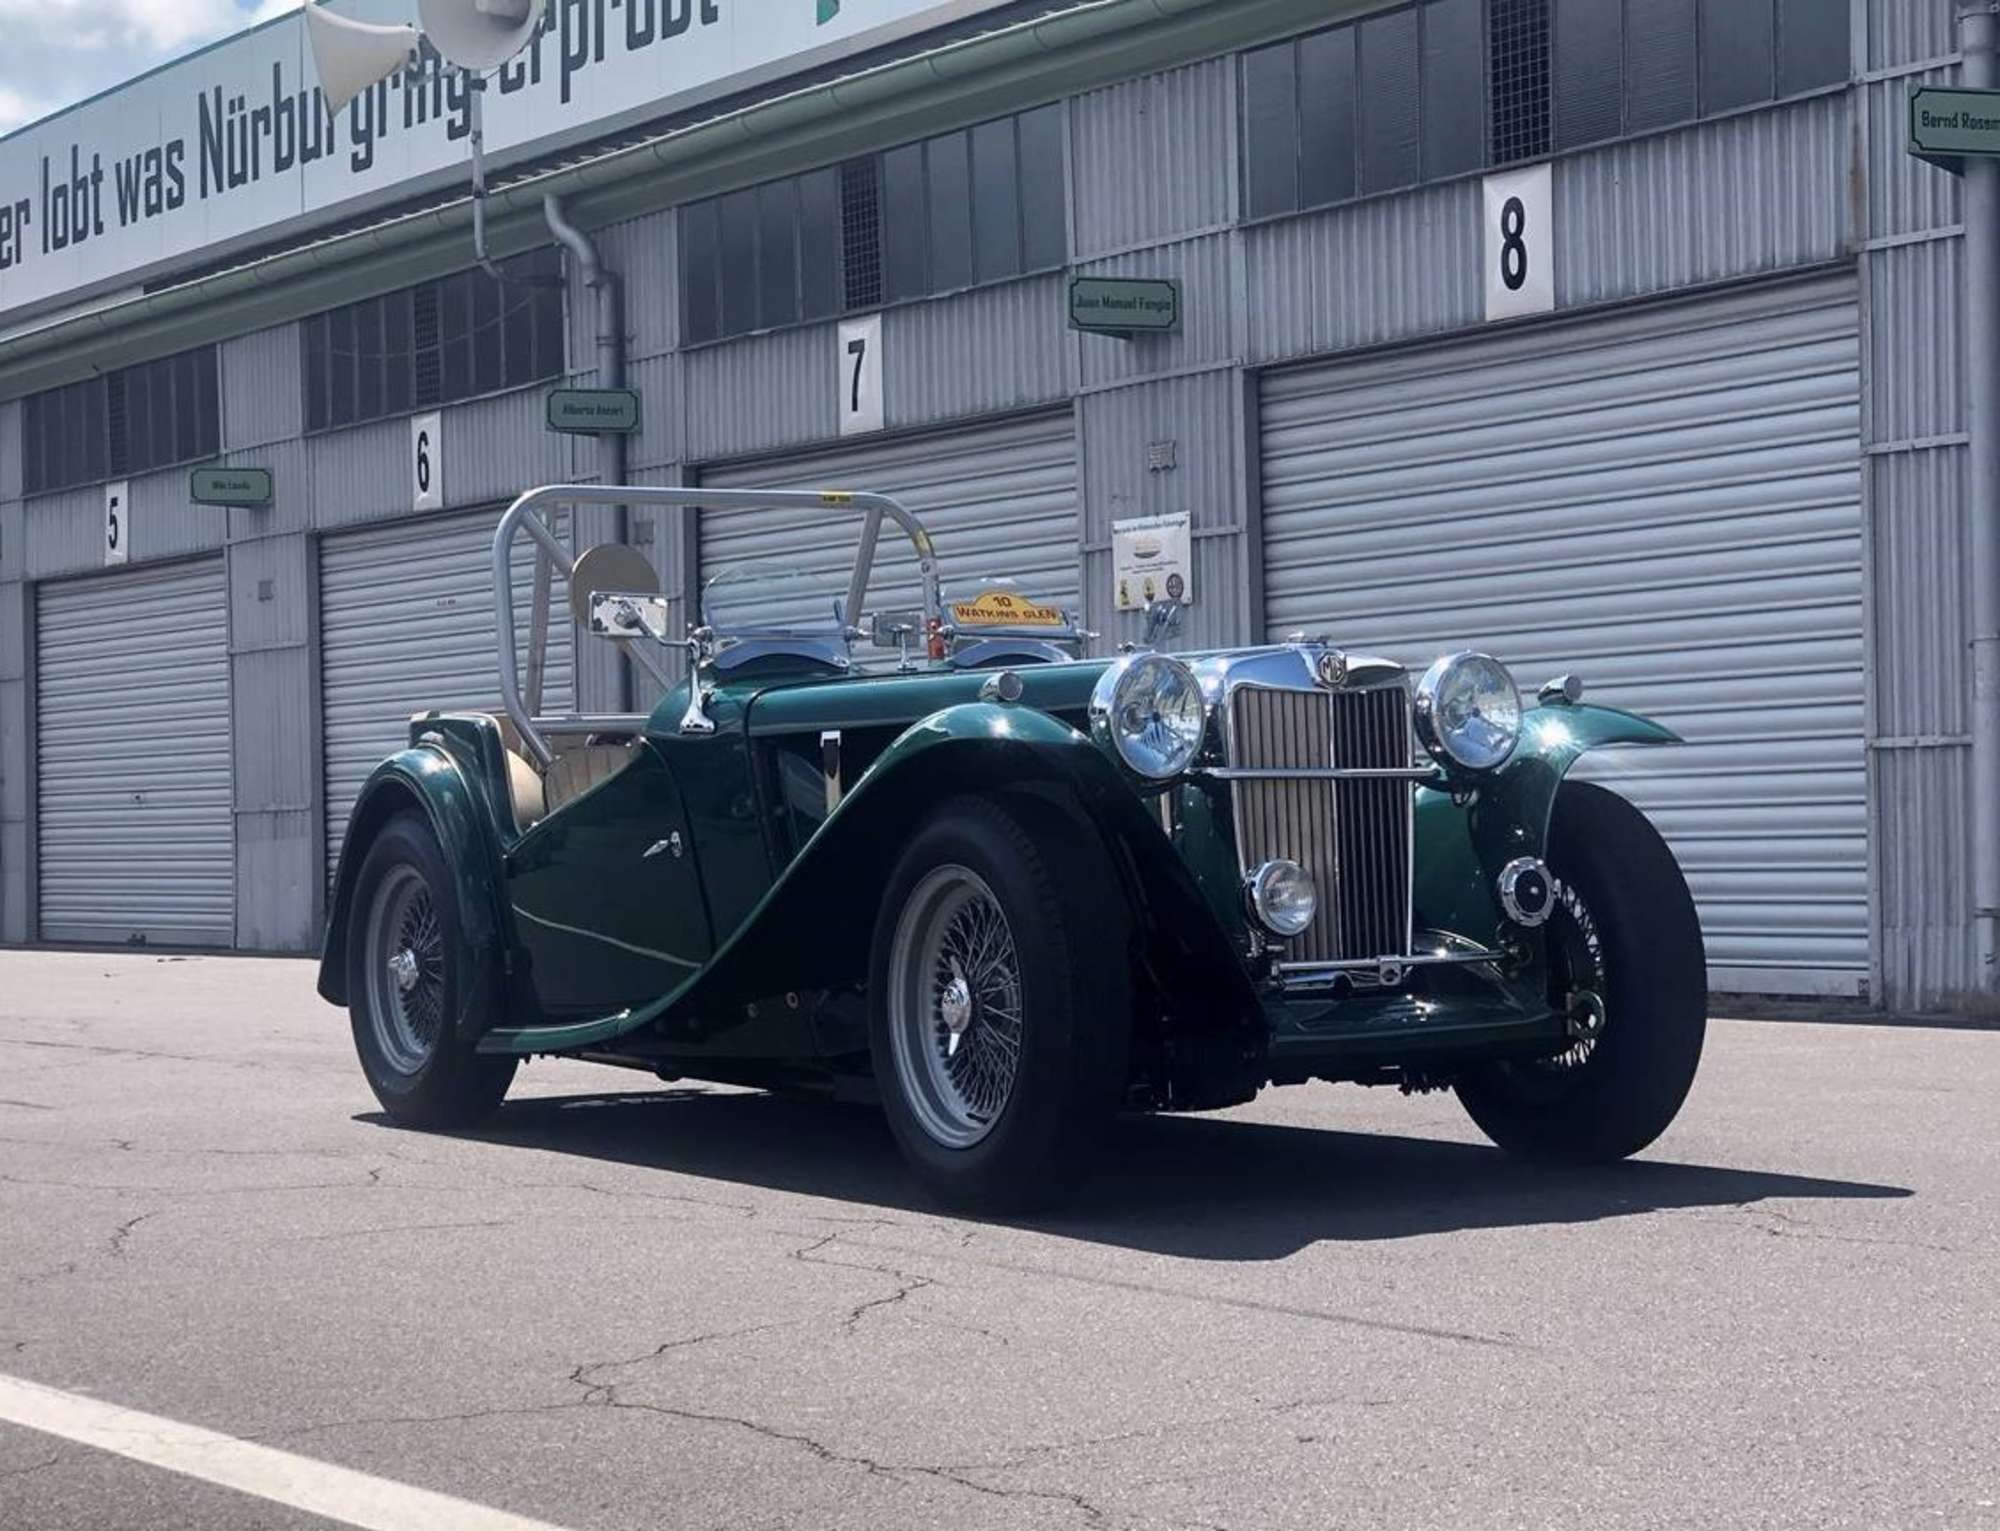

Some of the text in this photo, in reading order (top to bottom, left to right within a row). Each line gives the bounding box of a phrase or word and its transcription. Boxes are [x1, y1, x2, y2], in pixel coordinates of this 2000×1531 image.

[1921, 110, 1959, 129] Bernd
[42, 144, 104, 255] lobt
[115, 138, 185, 227] was
[1501, 196, 1526, 291] 8
[847, 338, 865, 412] 7
[416, 430, 430, 494] 6
[108, 497, 119, 550] 5
[955, 606, 1058, 620] WATKINS GLEN
[992, 596, 1013, 608] 10
